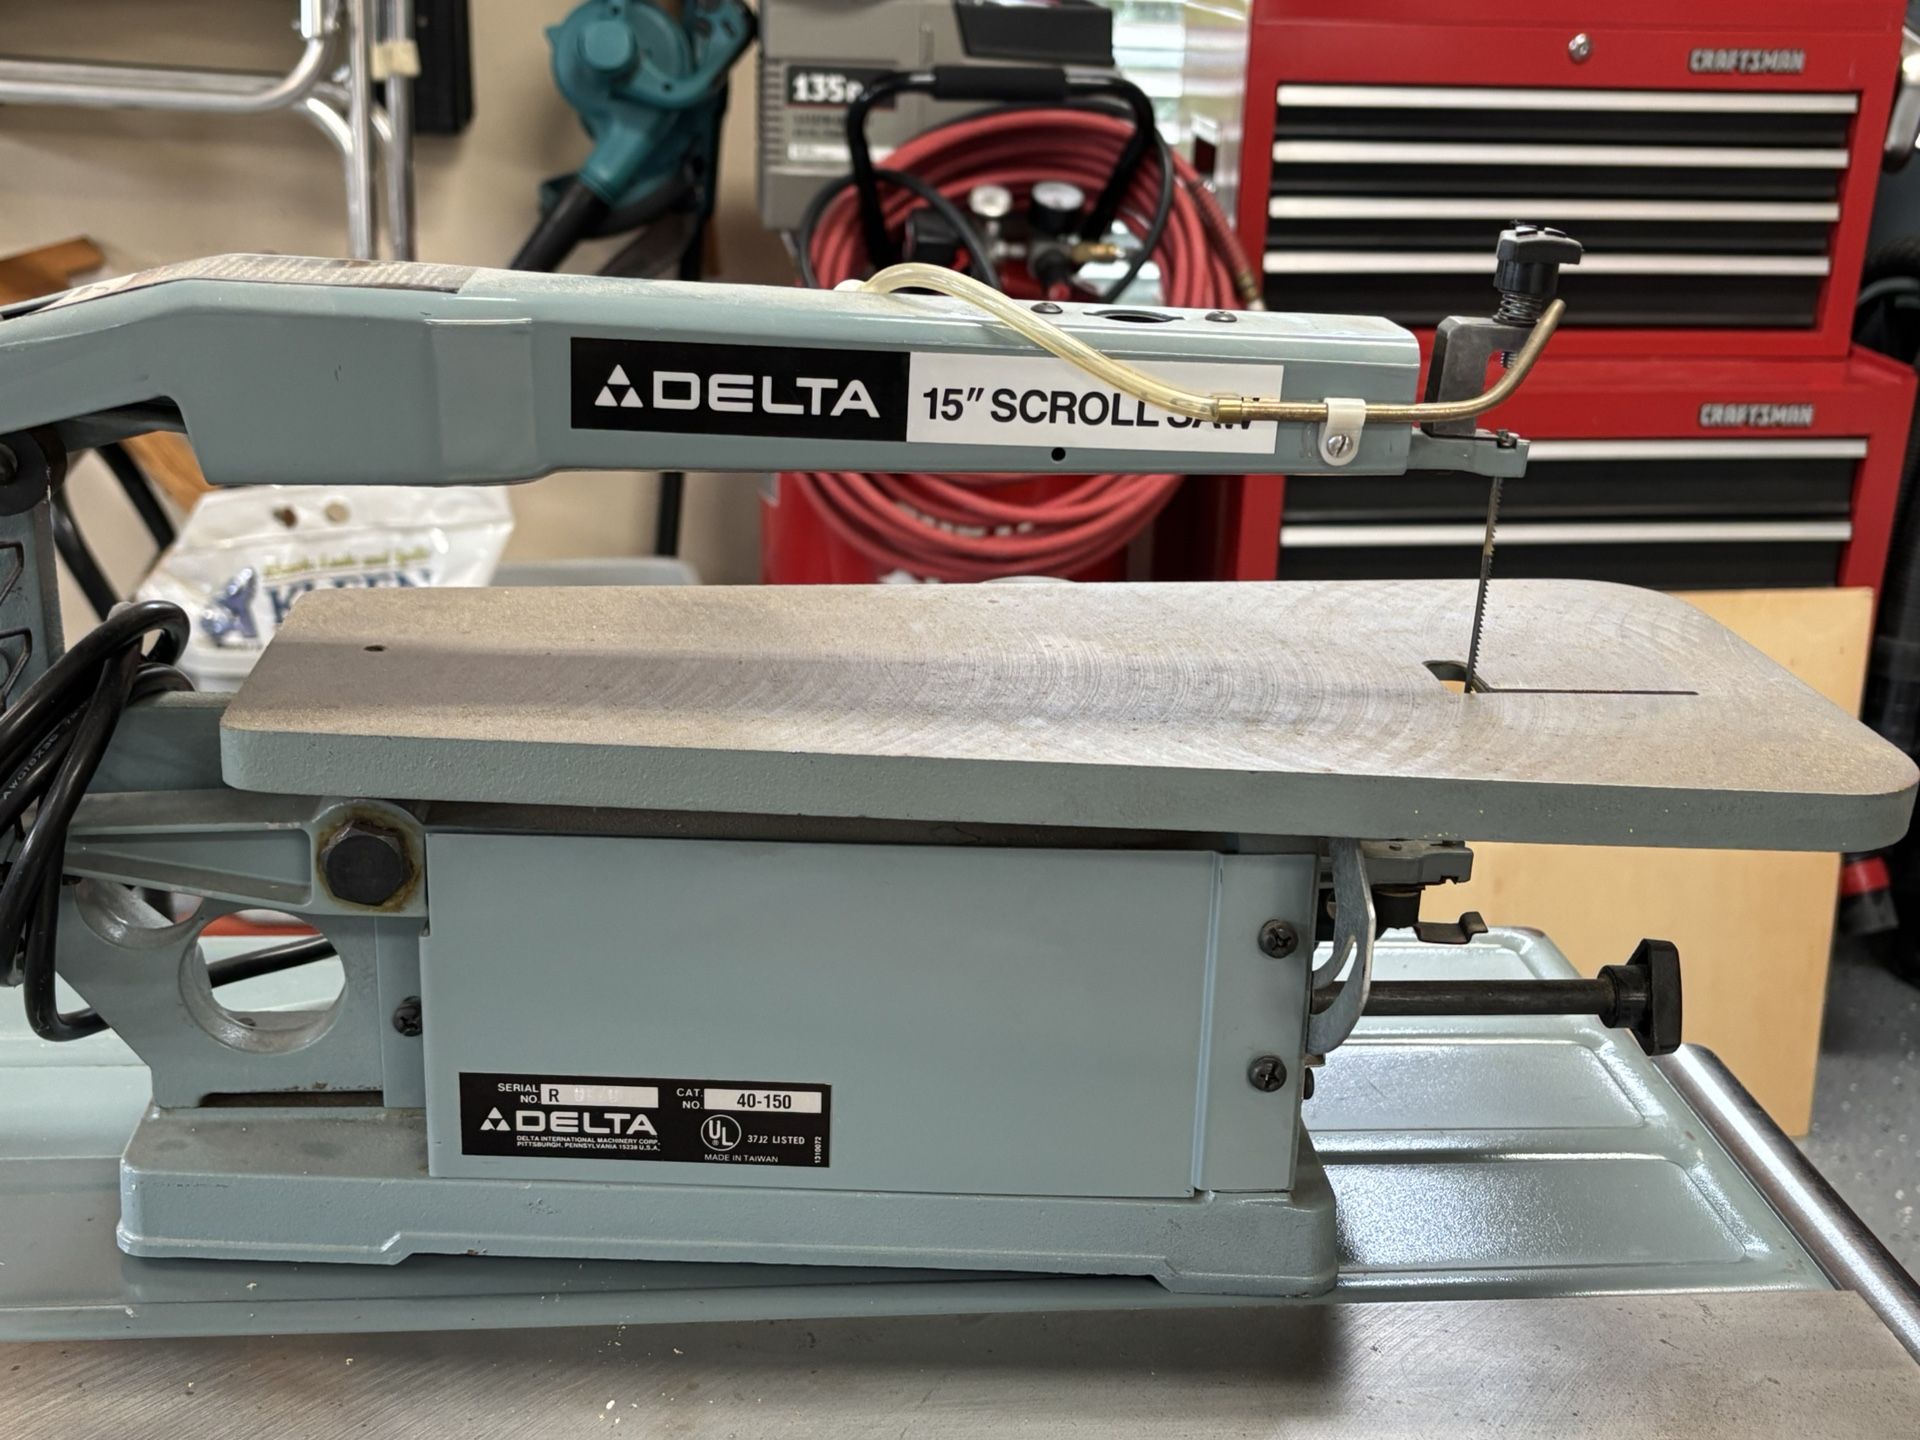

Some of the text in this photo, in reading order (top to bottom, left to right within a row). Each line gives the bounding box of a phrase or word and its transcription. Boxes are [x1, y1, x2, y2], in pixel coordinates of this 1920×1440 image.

[1689, 48, 1806, 75] CRAFTSMAN
[652, 370, 881, 418] DELTA
[990, 388, 1159, 428] SCROLL
[1699, 402, 1815, 429] CRAFTSMAN
[497, 1083, 539, 1093] SERIAL
[520, 1088, 560, 1104] NO. R
[676, 1088, 703, 1098] CAT.
[682, 1093, 792, 1110] NO. 40-150
[515, 1110, 658, 1136] DELTA
[540, 1136, 596, 1144] INTERNATIONAL
[597, 1137, 638, 1145] MACHINERY
[747, 1134, 806, 1146] 37J2 LISTED
[704, 1153, 779, 1163] MADE IN TAIWAN
